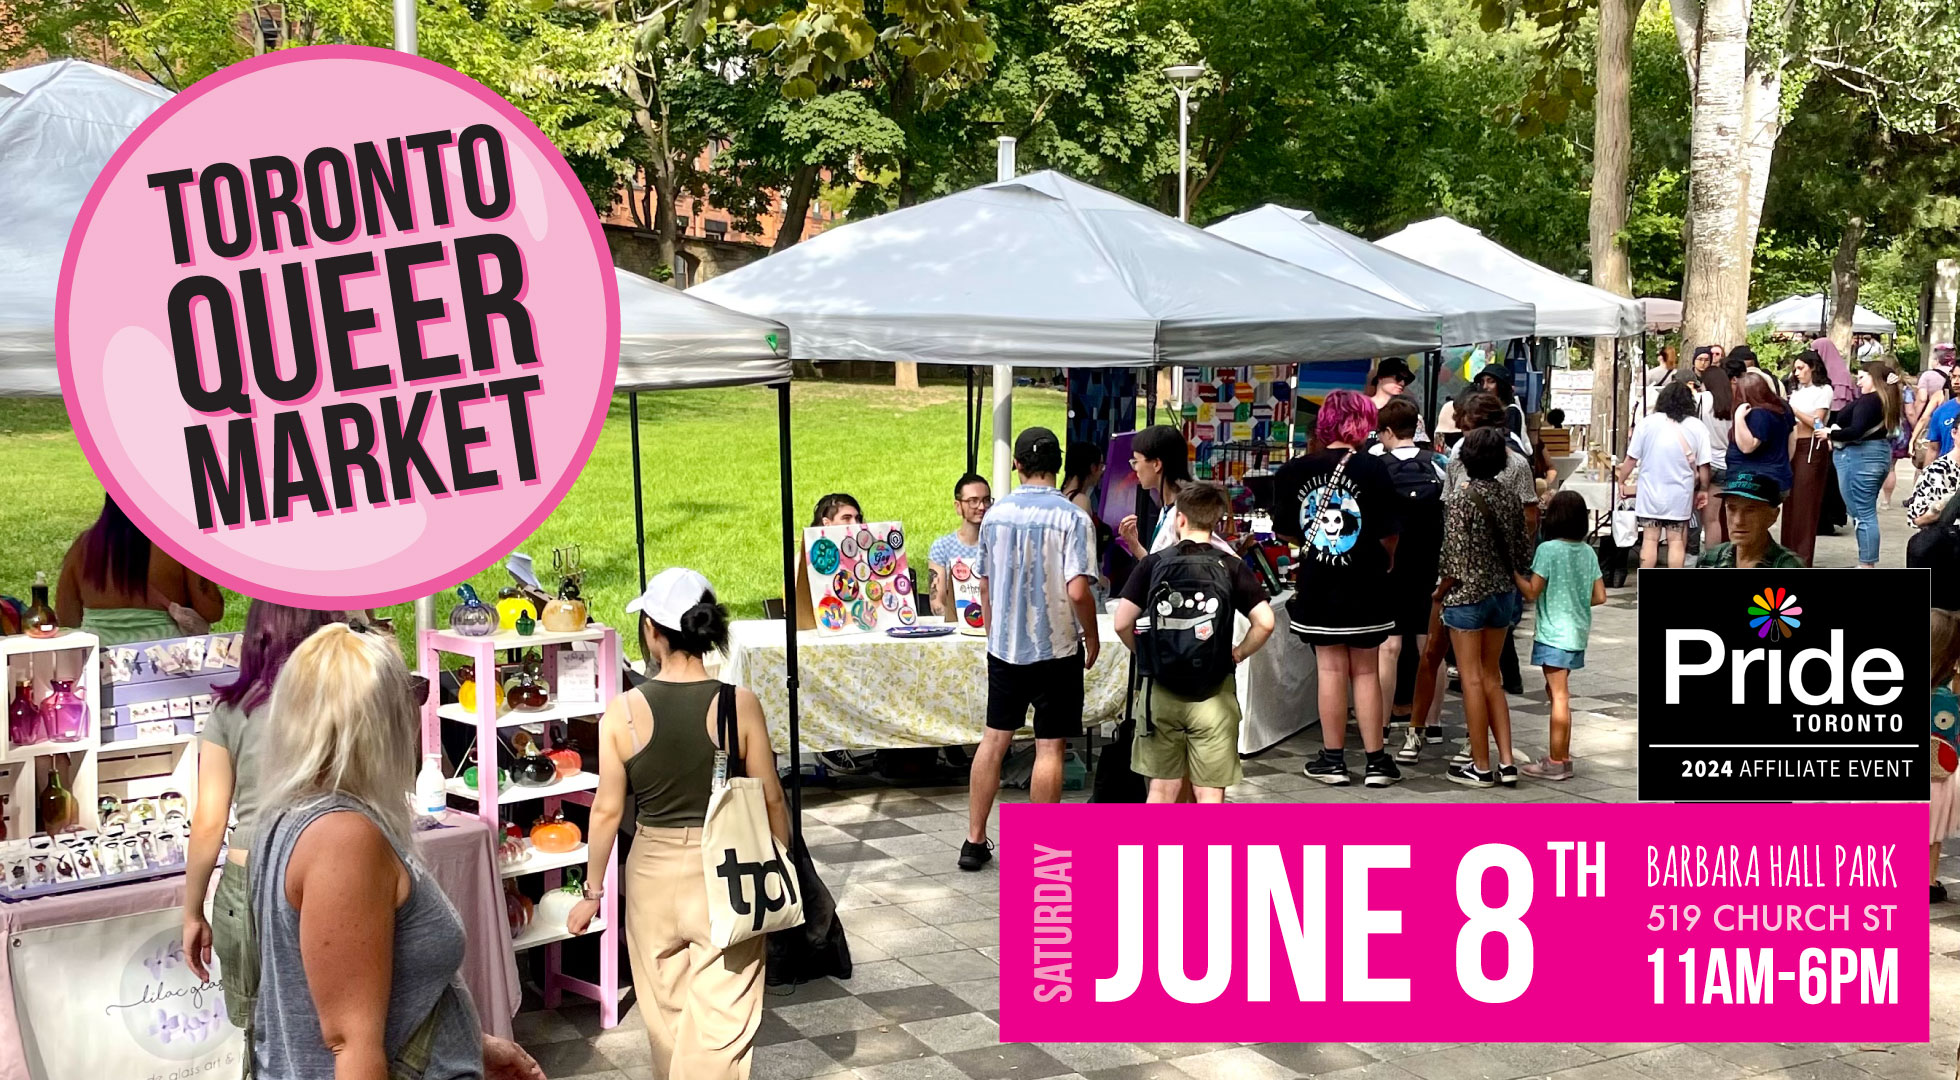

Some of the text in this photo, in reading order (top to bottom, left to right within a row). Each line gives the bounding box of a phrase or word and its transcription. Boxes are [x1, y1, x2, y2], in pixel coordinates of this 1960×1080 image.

[716, 848, 798, 932] tpl
[169, 1066, 200, 1080] glass
[203, 1057, 221, 1071] art
[225, 1052, 234, 1065] &
